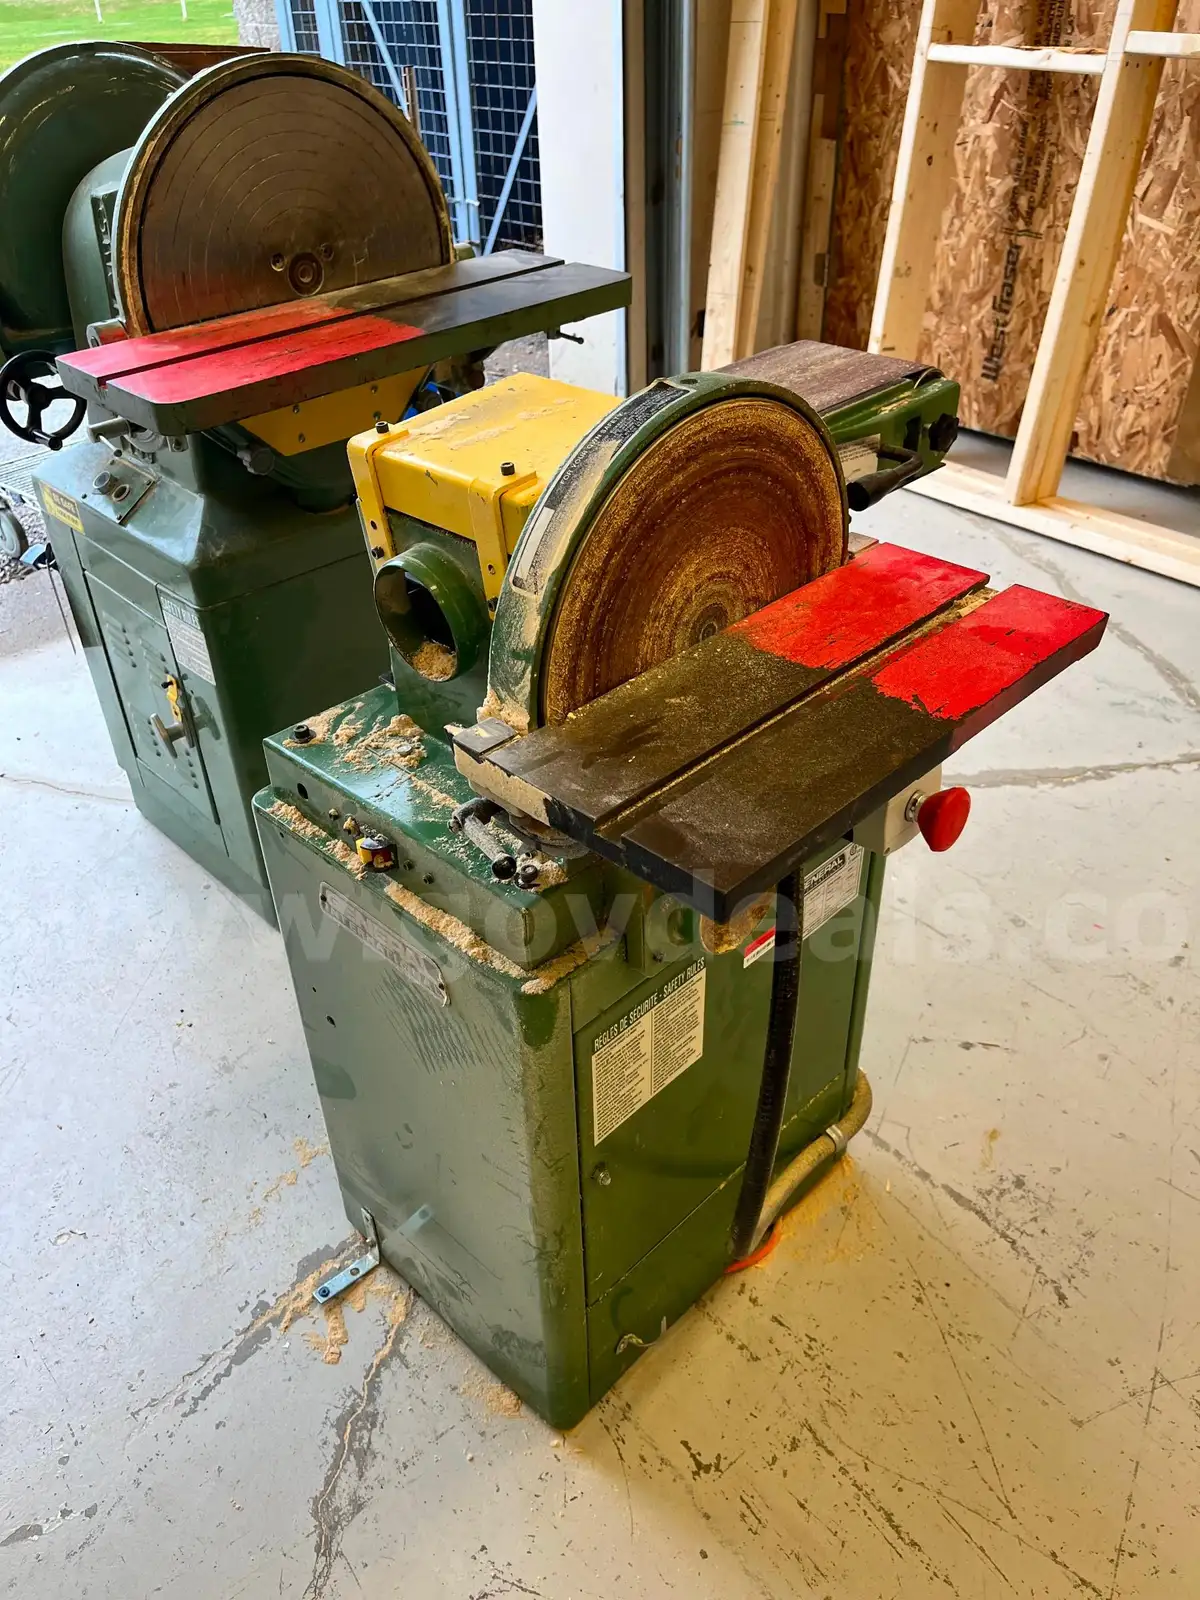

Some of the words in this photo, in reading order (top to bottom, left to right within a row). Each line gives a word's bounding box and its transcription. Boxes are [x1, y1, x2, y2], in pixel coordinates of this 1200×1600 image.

[981, 316, 1009, 383] West
[561, 469, 572, 485] FOR
[571, 450, 587, 469] YOUR
[804, 857, 843, 890] ENERAL
[594, 1023, 617, 1051] RÈGLES
[619, 1017, 628, 1032] DE
[629, 991, 658, 1023] SÉCURITÉ
[663, 973, 685, 997] SAFETY
[686, 956, 705, 980] RULES
